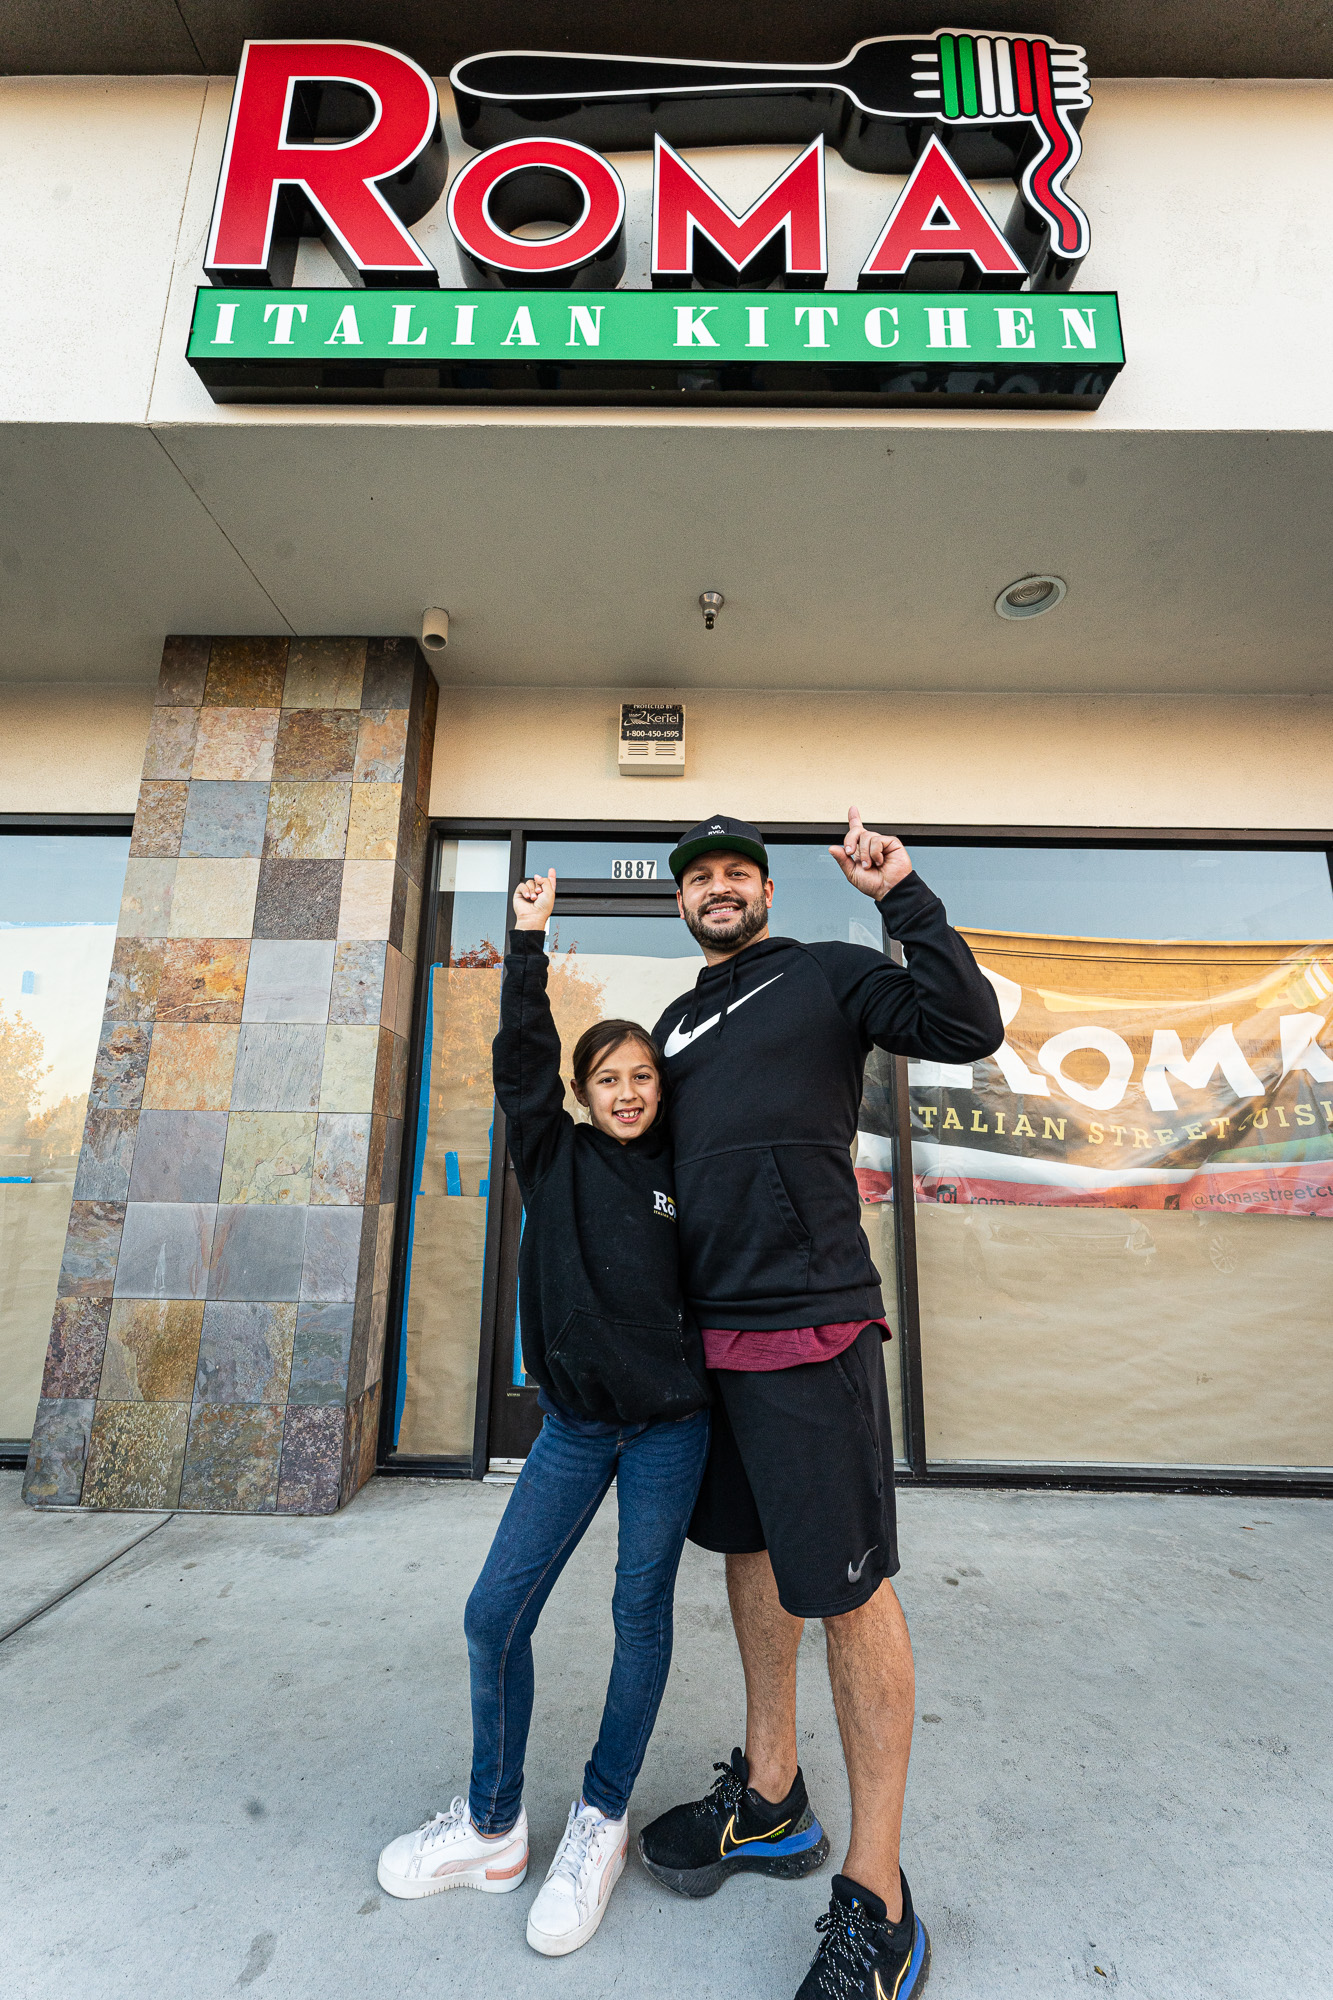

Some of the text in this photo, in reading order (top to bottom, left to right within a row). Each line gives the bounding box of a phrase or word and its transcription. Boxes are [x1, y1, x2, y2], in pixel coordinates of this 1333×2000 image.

[203, 38, 1029, 274] ROMA
[210, 303, 1097, 349] ITALIAN KITCHEN
[647, 713, 679, 723] KerTel
[626, 730, 680, 738] 1-800-450-1595
[613, 860, 656, 879] 8887
[910, 1106, 1068, 1140] TALIAN
[1088, 1117, 1231, 1149] STREET
[653, 1190, 677, 1218] Ro
